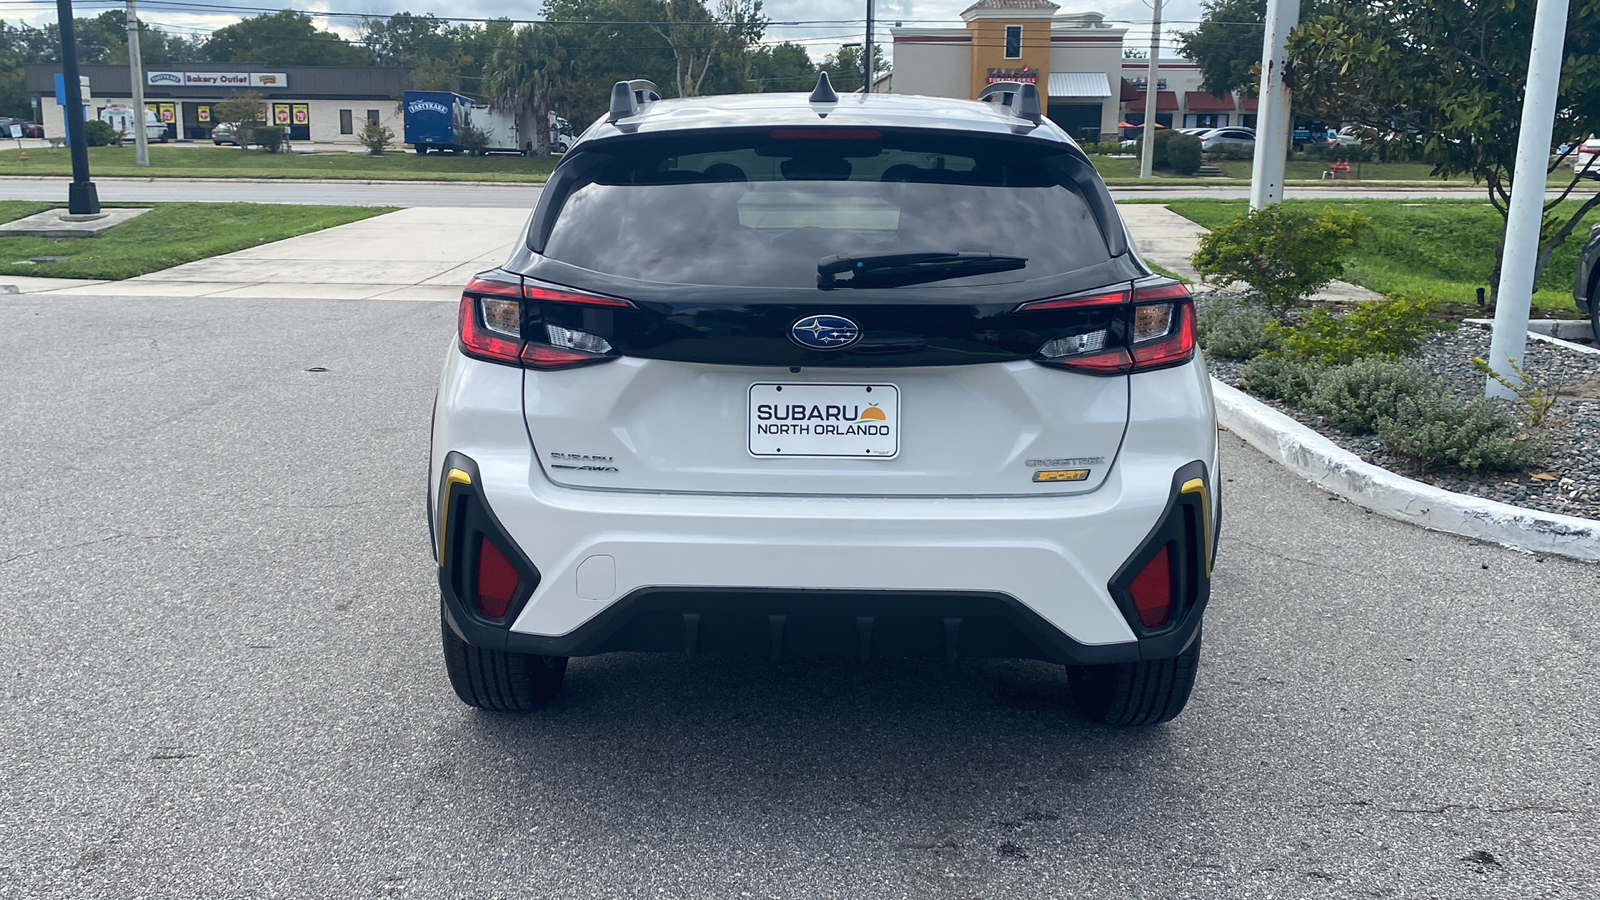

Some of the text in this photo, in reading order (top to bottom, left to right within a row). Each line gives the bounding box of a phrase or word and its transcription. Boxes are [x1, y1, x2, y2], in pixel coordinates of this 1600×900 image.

[187, 75, 247, 84] Bakery Outlet
[410, 103, 447, 113] TASTYKAKE
[757, 404, 859, 422] SUBARU
[757, 424, 890, 436] NORTH ORLANDO
[550, 452, 613, 463] SUBARU
[1025, 456, 1105, 467] CROSSTREK
[1037, 470, 1085, 480] SPORT
